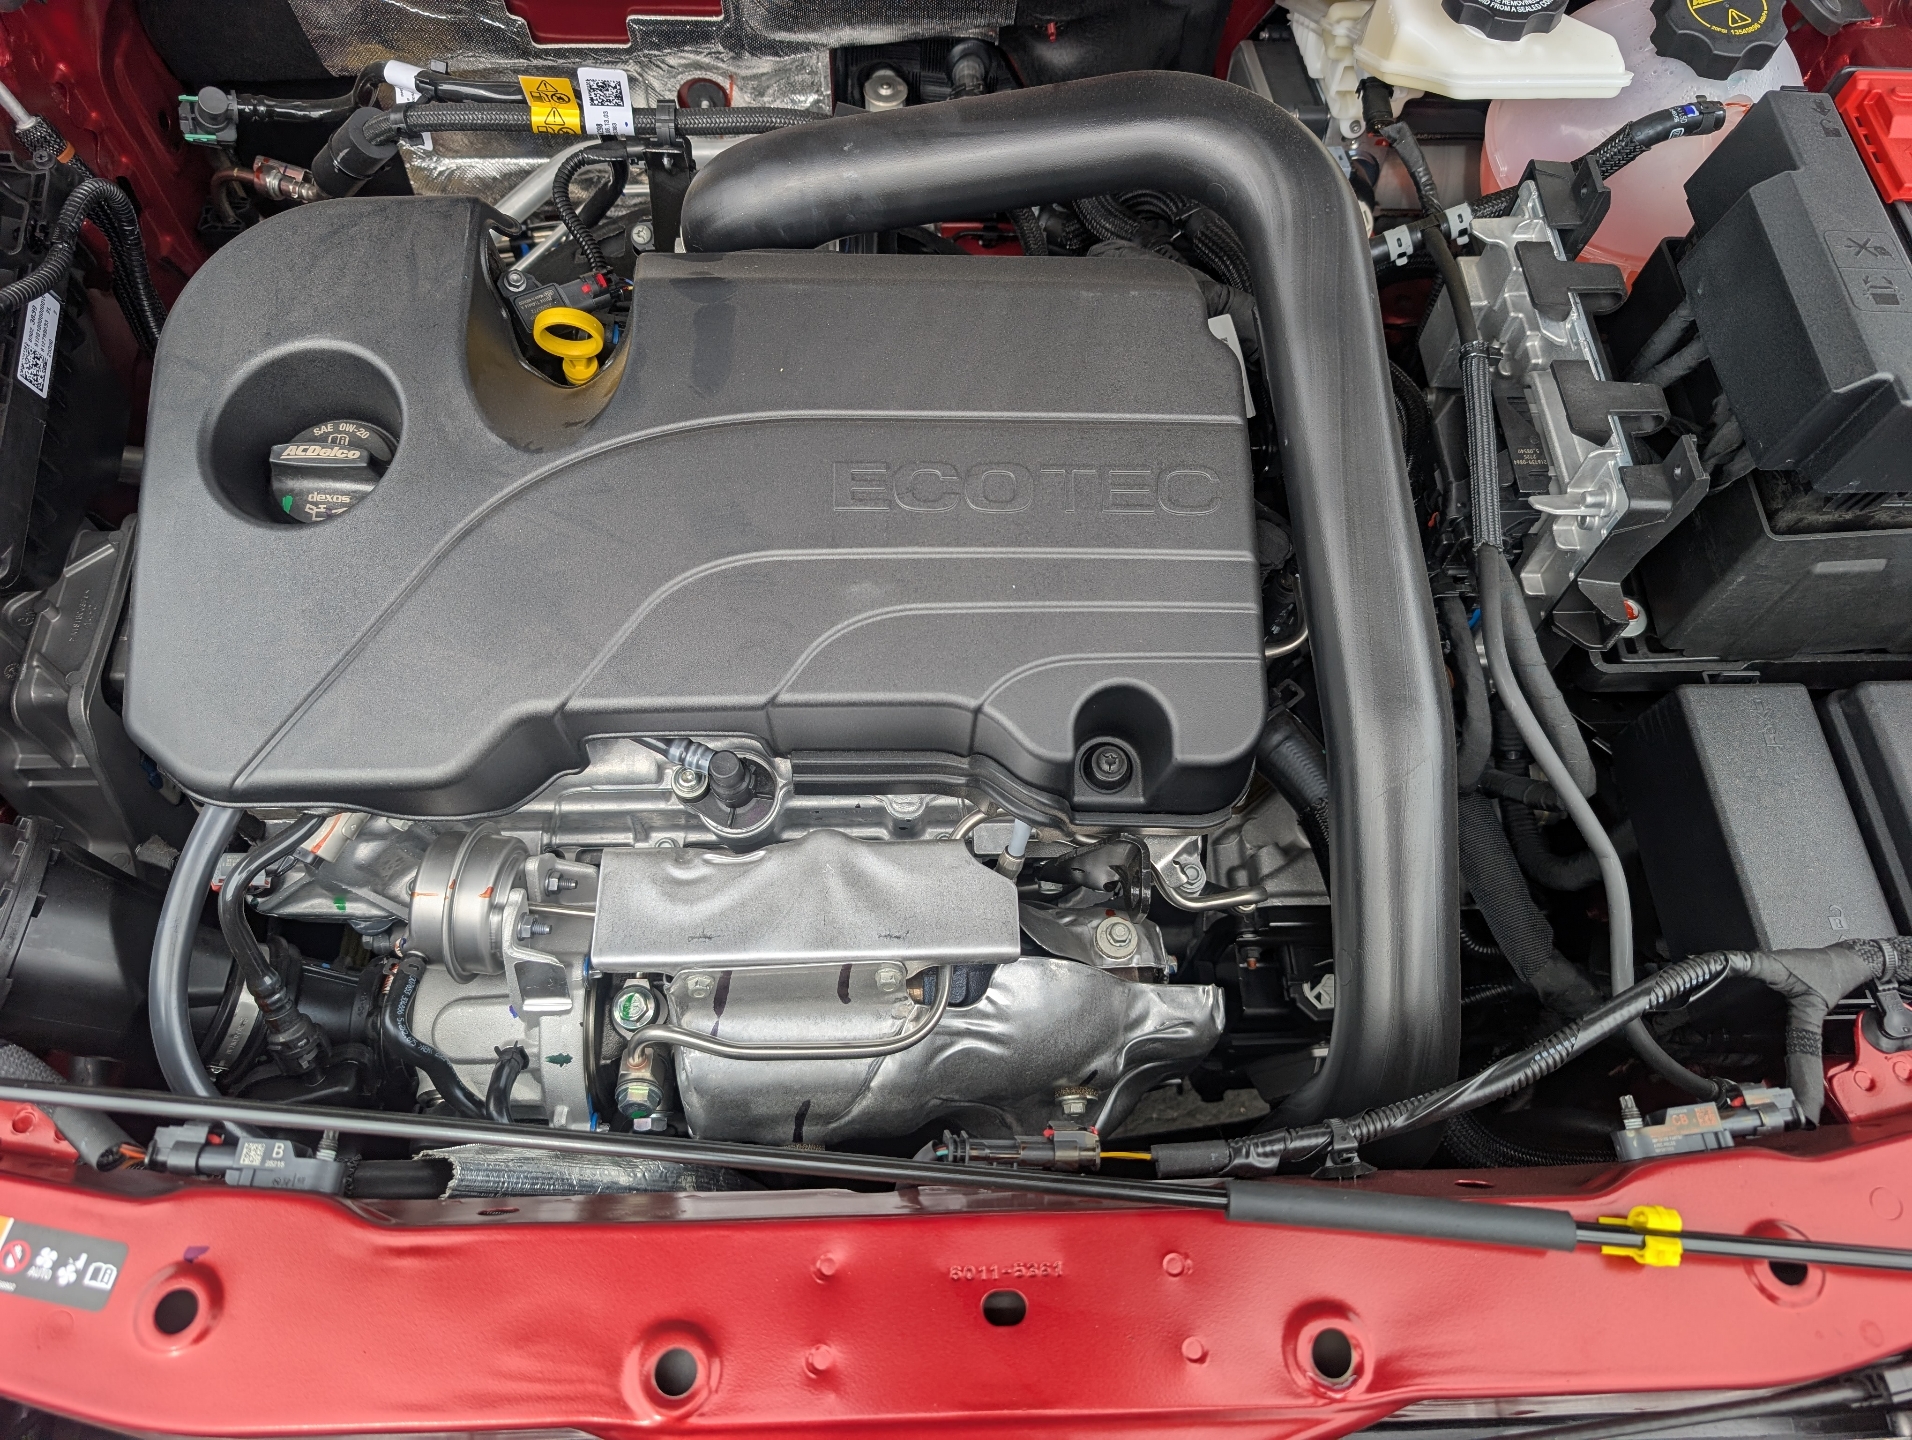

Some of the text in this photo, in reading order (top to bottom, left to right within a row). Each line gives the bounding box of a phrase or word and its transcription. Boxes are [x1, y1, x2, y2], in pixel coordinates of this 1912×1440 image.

[1490, 2, 1510, 11] FROM
[1517, 4, 1542, 12] SEALED
[313, 422, 370, 439] SAE 0W-20
[281, 445, 361, 459] ACDelco
[833, 461, 1222, 516] ECOTEC
[307, 491, 352, 503] dexos
[272, 1142, 285, 1158] B
